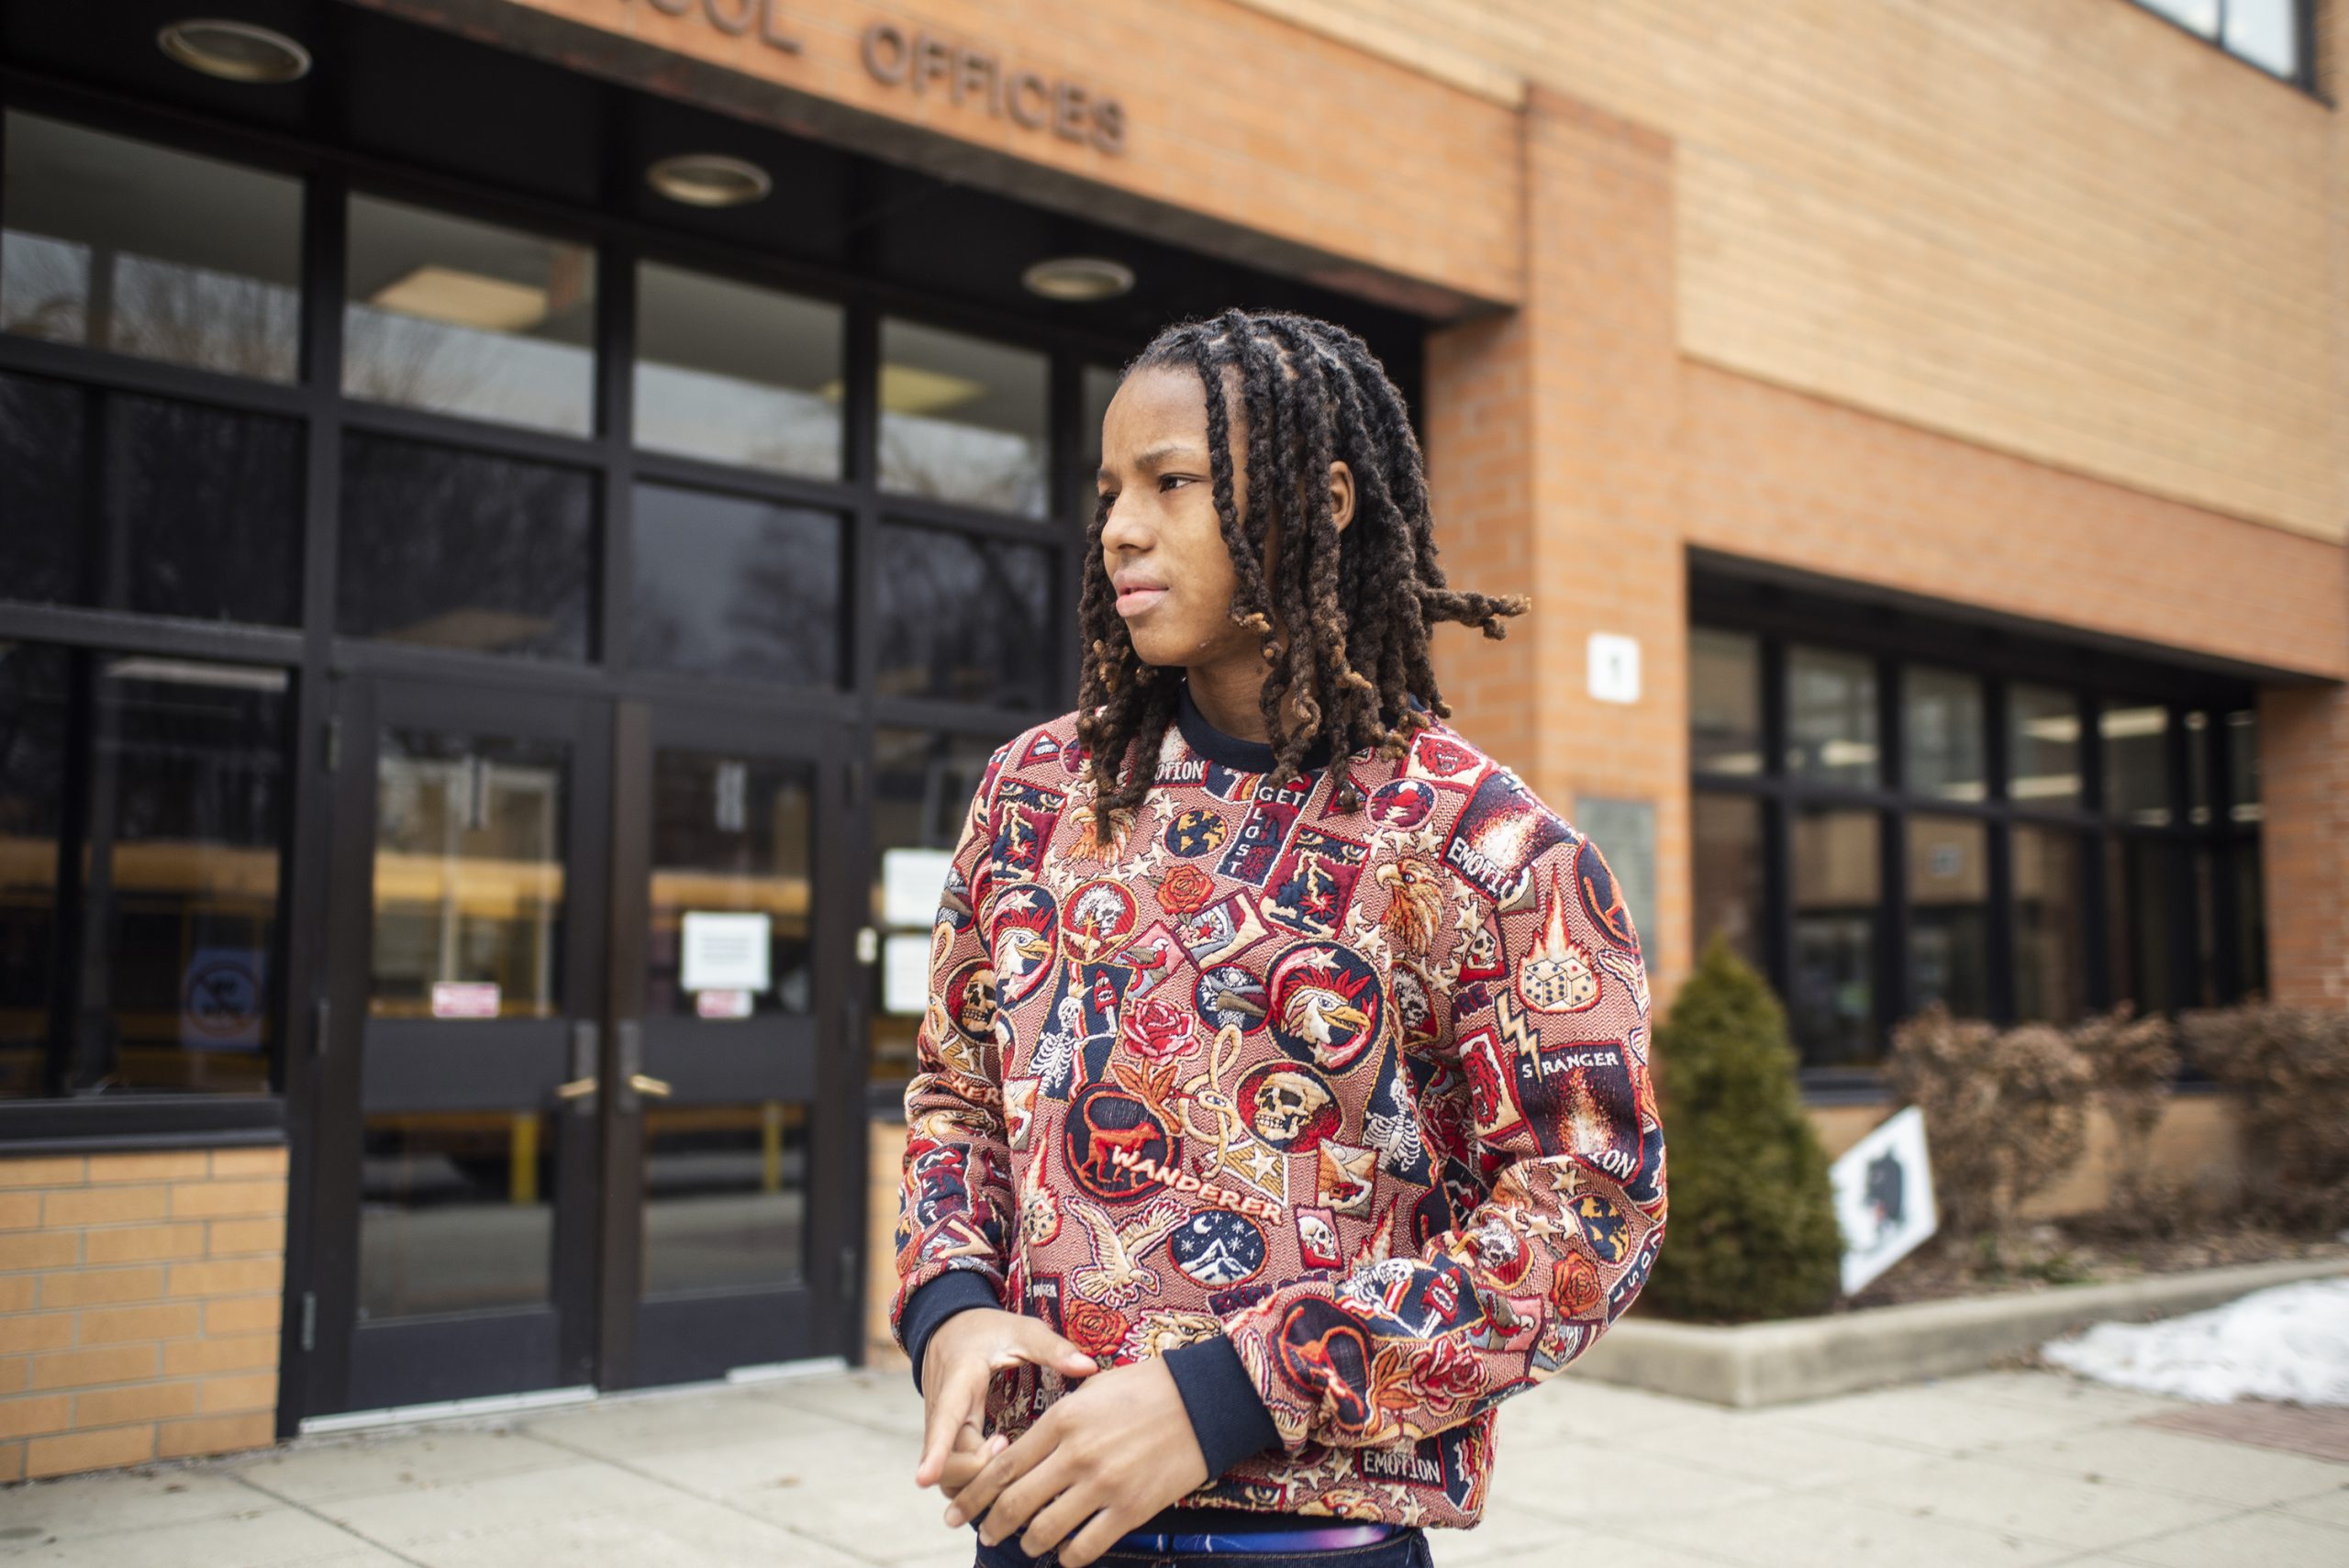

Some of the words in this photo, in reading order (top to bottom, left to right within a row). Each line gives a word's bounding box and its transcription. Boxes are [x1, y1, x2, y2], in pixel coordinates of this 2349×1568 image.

[861, 22, 1129, 154] OFFICES
[1154, 761, 1206, 781] OTION
[1259, 785, 1305, 806] GET
[1230, 806, 1264, 873] LOST
[1447, 836, 1513, 898] EMOTI
[1521, 1051, 1620, 1079] SRANGER
[1110, 1145, 1283, 1227] WANDERER
[1363, 1450, 1441, 1484] EMOTION
